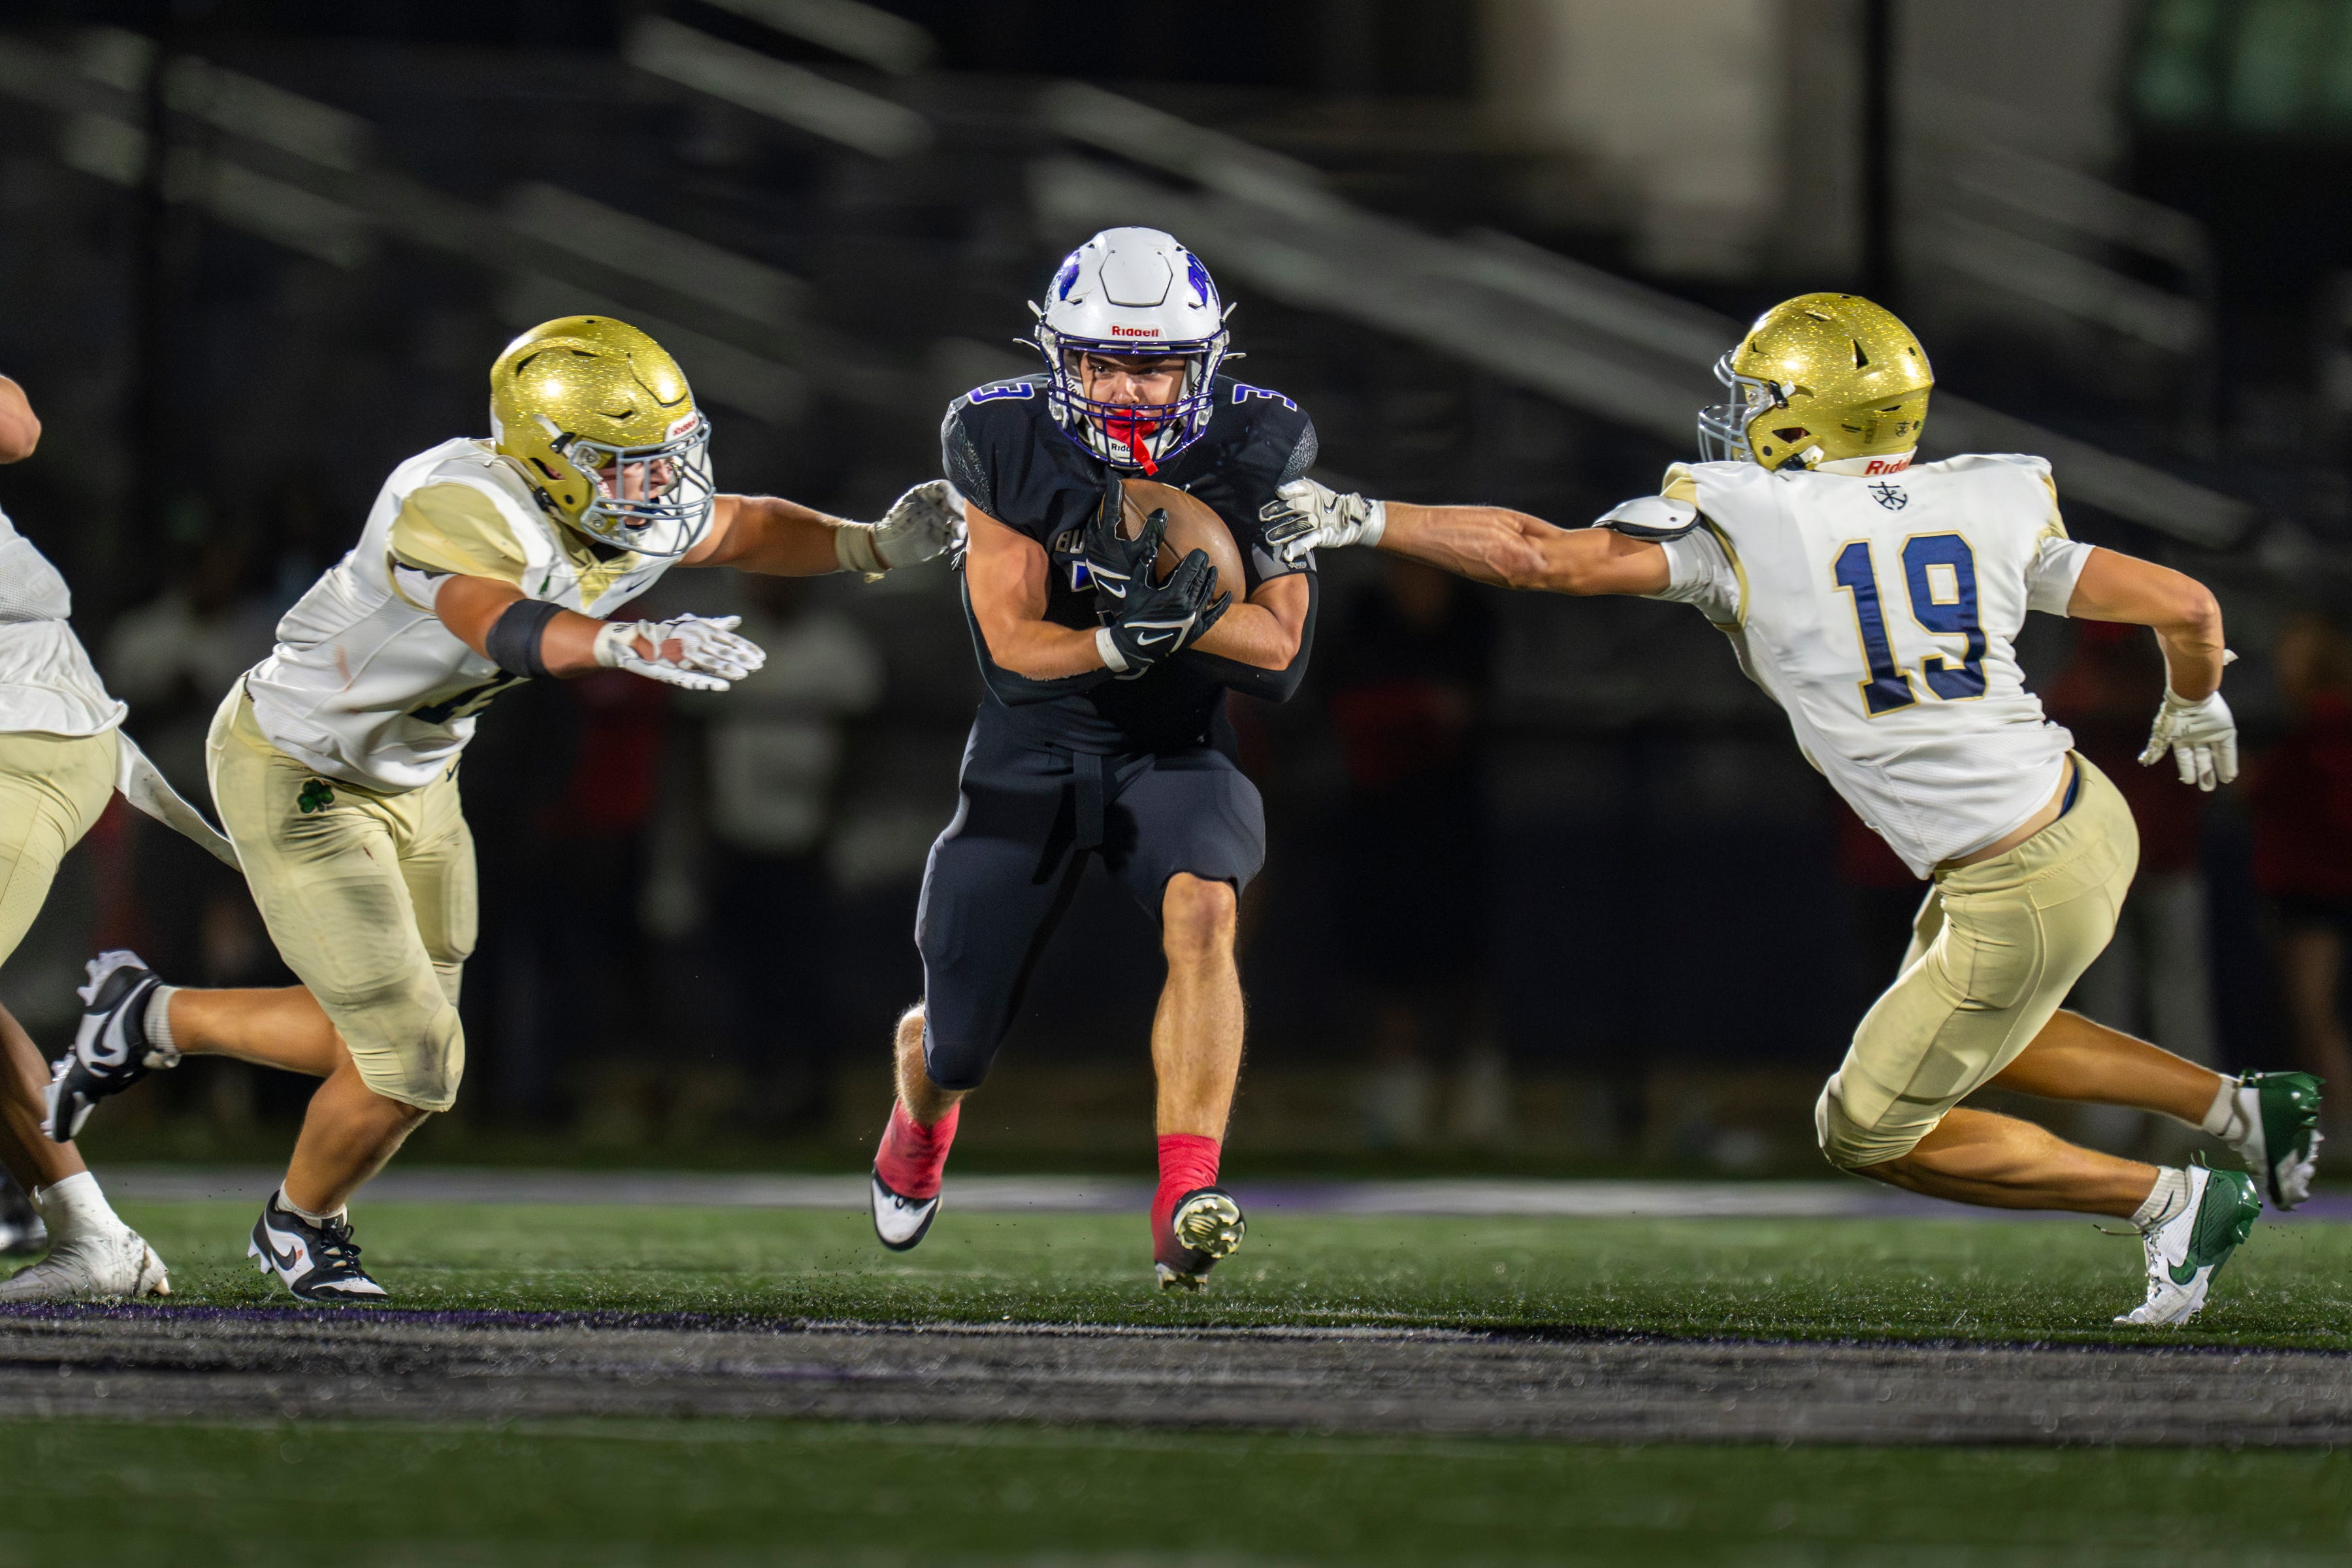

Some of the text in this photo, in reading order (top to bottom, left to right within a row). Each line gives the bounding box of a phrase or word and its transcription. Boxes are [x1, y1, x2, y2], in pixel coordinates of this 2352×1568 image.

[1112, 325, 1159, 337] Riddell
[966, 382, 1035, 405] 3
[1232, 384, 1298, 412] 3
[1865, 458, 1912, 476] Ridd
[1829, 530, 1990, 719] 19
